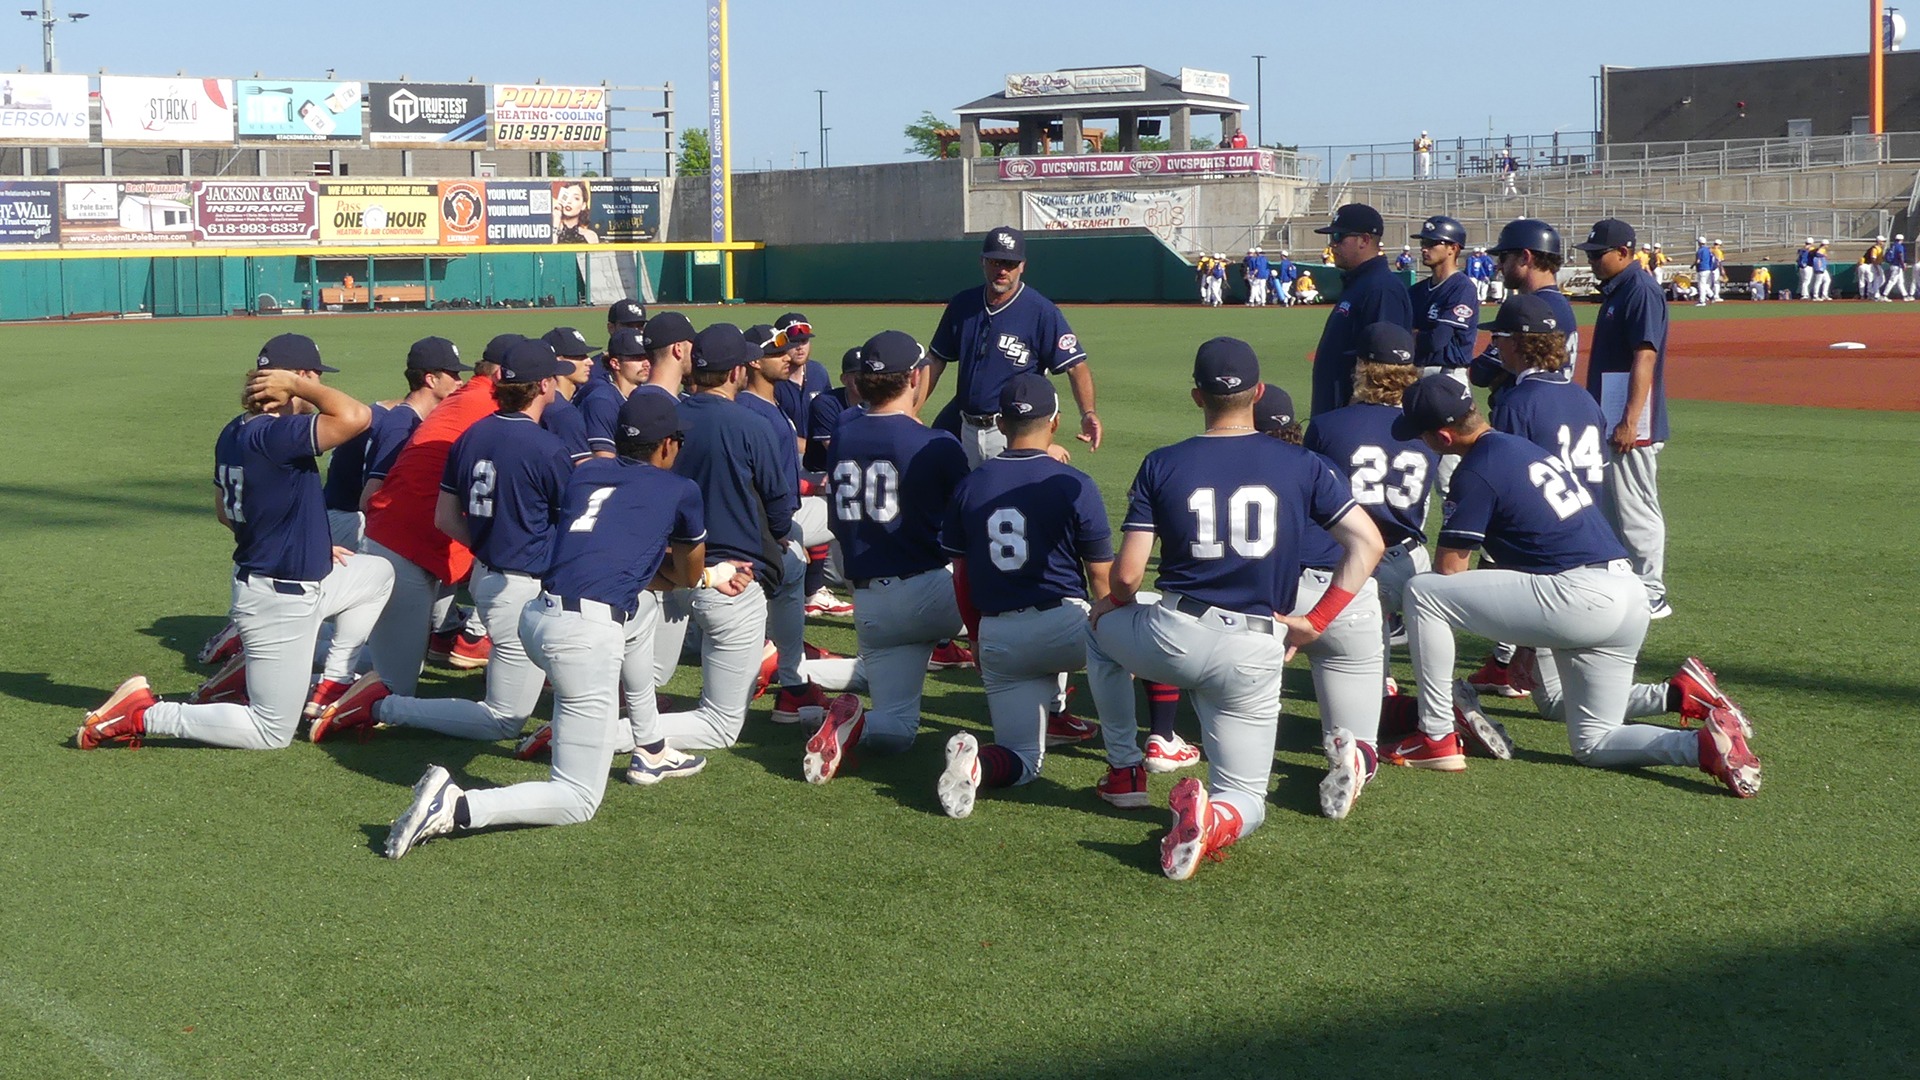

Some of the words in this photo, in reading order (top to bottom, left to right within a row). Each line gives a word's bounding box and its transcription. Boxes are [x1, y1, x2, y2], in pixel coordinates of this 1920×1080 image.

[419, 97, 468, 113] TRUETEST
[497, 87, 604, 110] PONDER
[711, 90, 721, 116] Bank
[497, 110, 548, 119] HEATING
[555, 111, 603, 121] COOLING
[712, 118, 723, 158] Legence
[1041, 161, 1123, 173] OVCSPORTS.COM
[1167, 156, 1253, 170] OVCSPORTS.COM
[206, 187, 260, 201] JACKSON
[262, 187, 271, 200] &
[273, 187, 305, 201] GRAY
[328, 185, 340, 195] WE
[341, 185, 365, 195] MAKE
[366, 186, 387, 195] YOUR
[487, 189, 506, 200] YOUR
[507, 189, 527, 200] VOICE
[336, 200, 361, 212] Pass
[1071, 194, 1085, 205] FOR
[1088, 193, 1109, 204] MORE
[206, 205, 306, 213] INSURANCE
[487, 205, 506, 216] YOUR
[507, 205, 529, 216] UNION
[1095, 205, 1121, 217] GAME?
[207, 223, 306, 233] 618-993-6337
[333, 212, 364, 228] ONE
[385, 212, 427, 228] HOUR
[1072, 218, 1114, 228] STRAIGHT
[488, 224, 506, 239] GET
[507, 224, 551, 239] INVOLVED
[997, 333, 1031, 366] USI
[1350, 445, 1429, 510] 23
[469, 459, 496, 518] 2
[832, 459, 899, 523] 20
[569, 486, 616, 533] 1
[1187, 484, 1278, 559] 10
[986, 506, 1030, 571] 8
